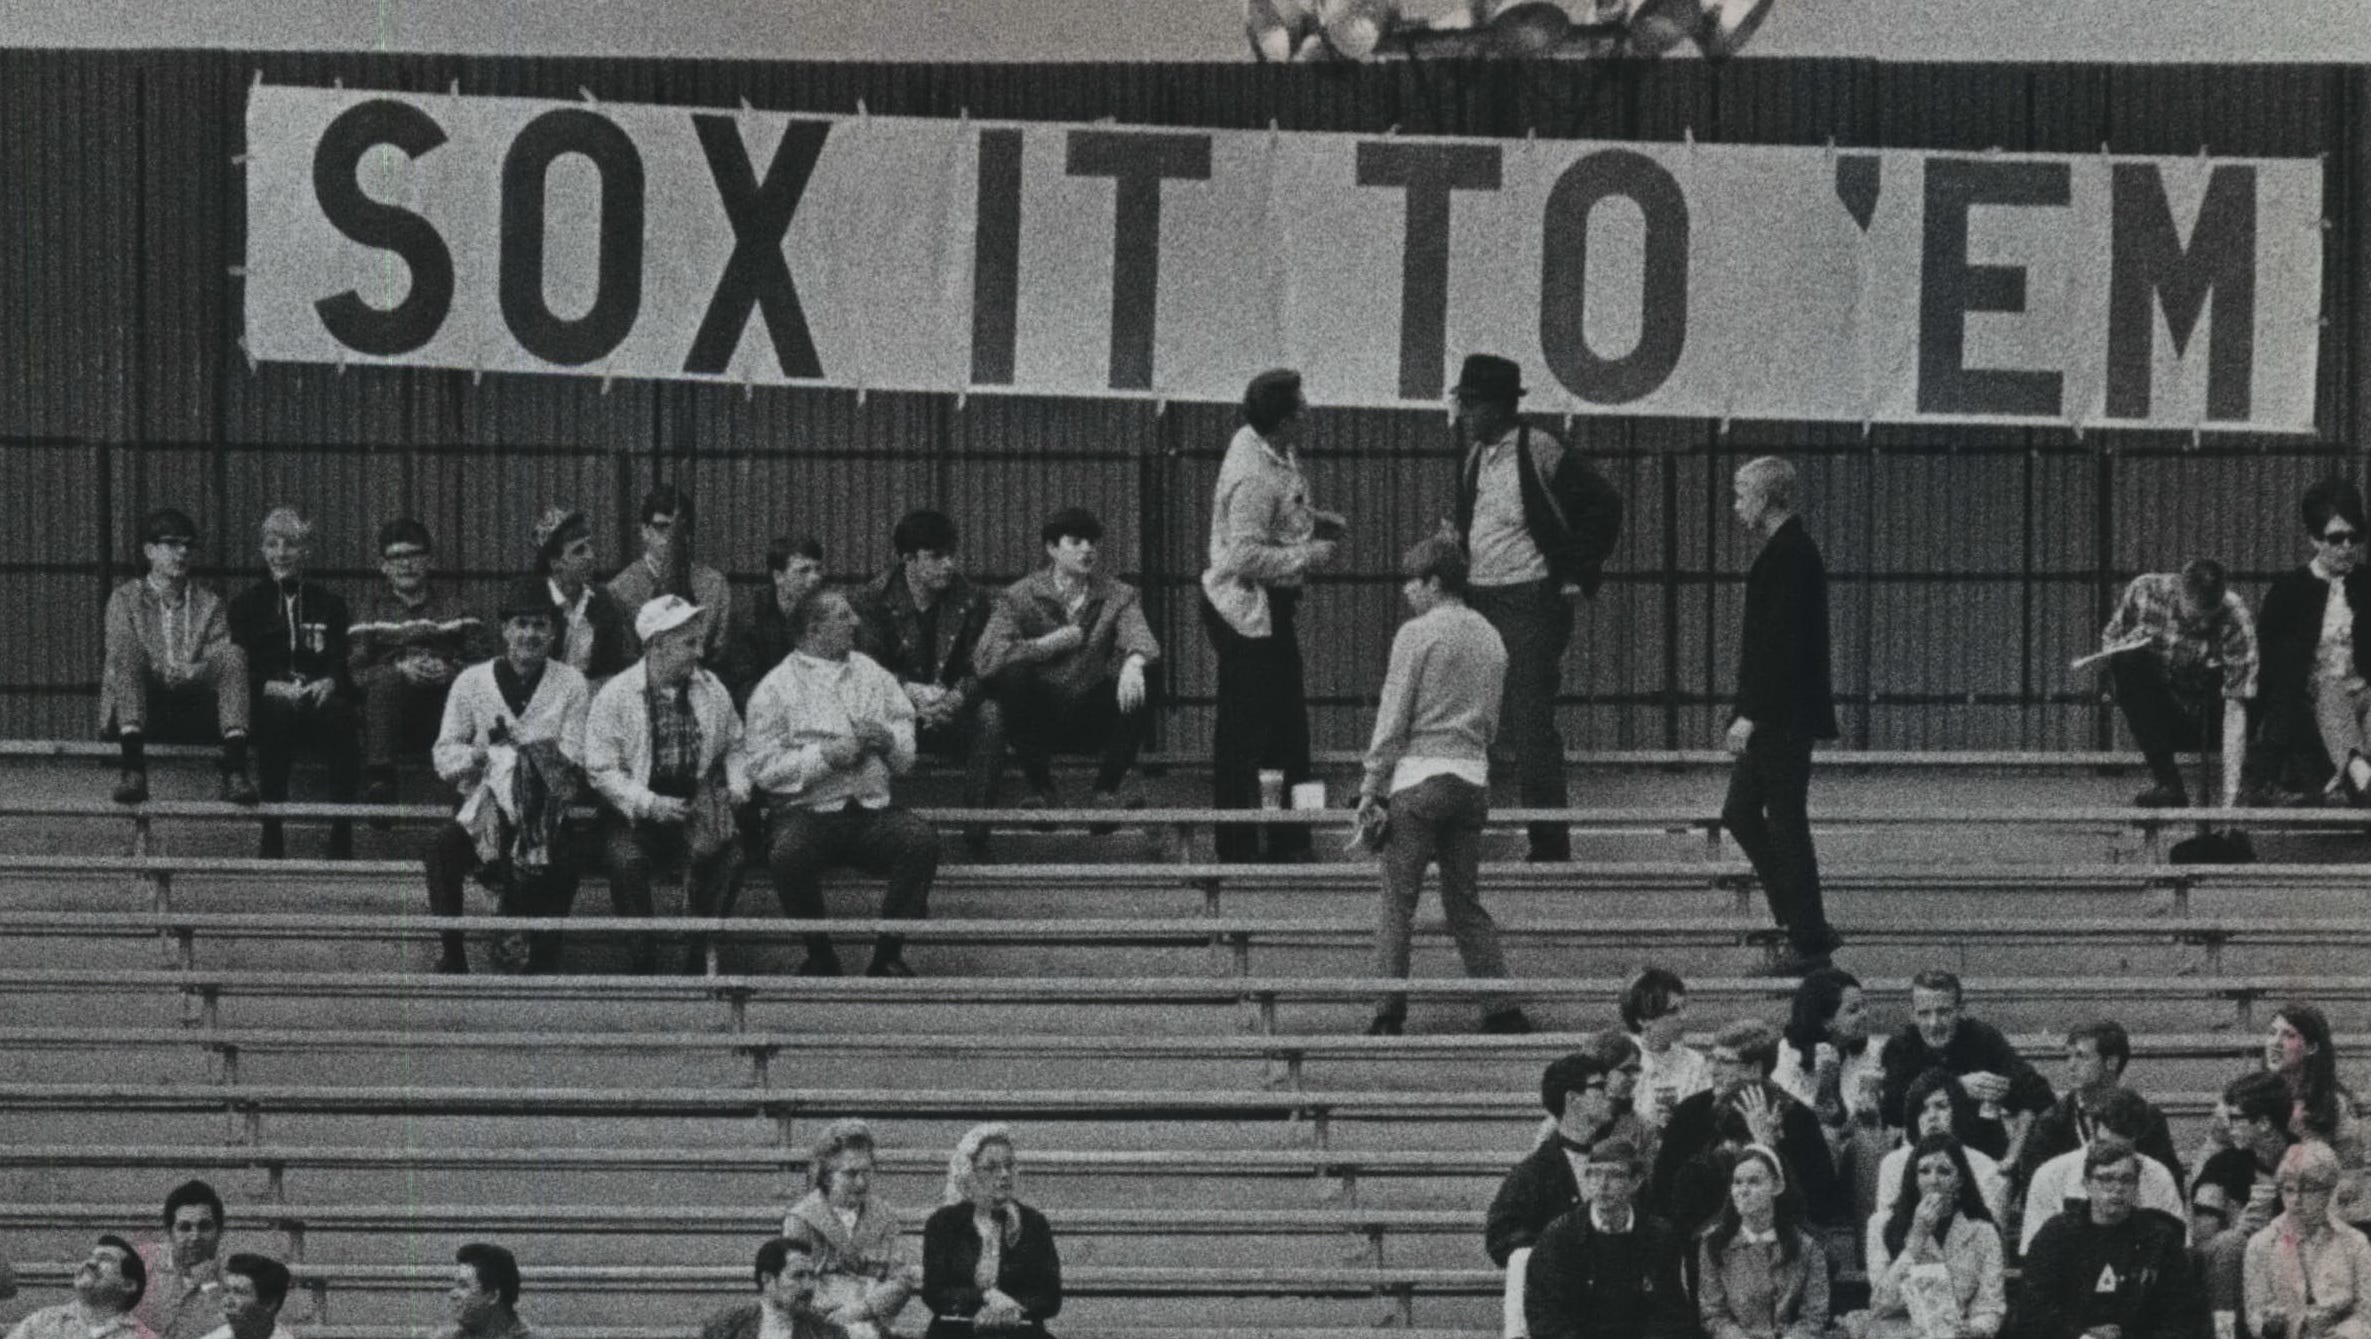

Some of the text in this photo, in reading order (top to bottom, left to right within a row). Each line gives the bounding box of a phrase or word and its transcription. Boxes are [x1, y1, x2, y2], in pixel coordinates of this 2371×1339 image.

[313, 99, 2257, 421] SOX IT TO 'EM
